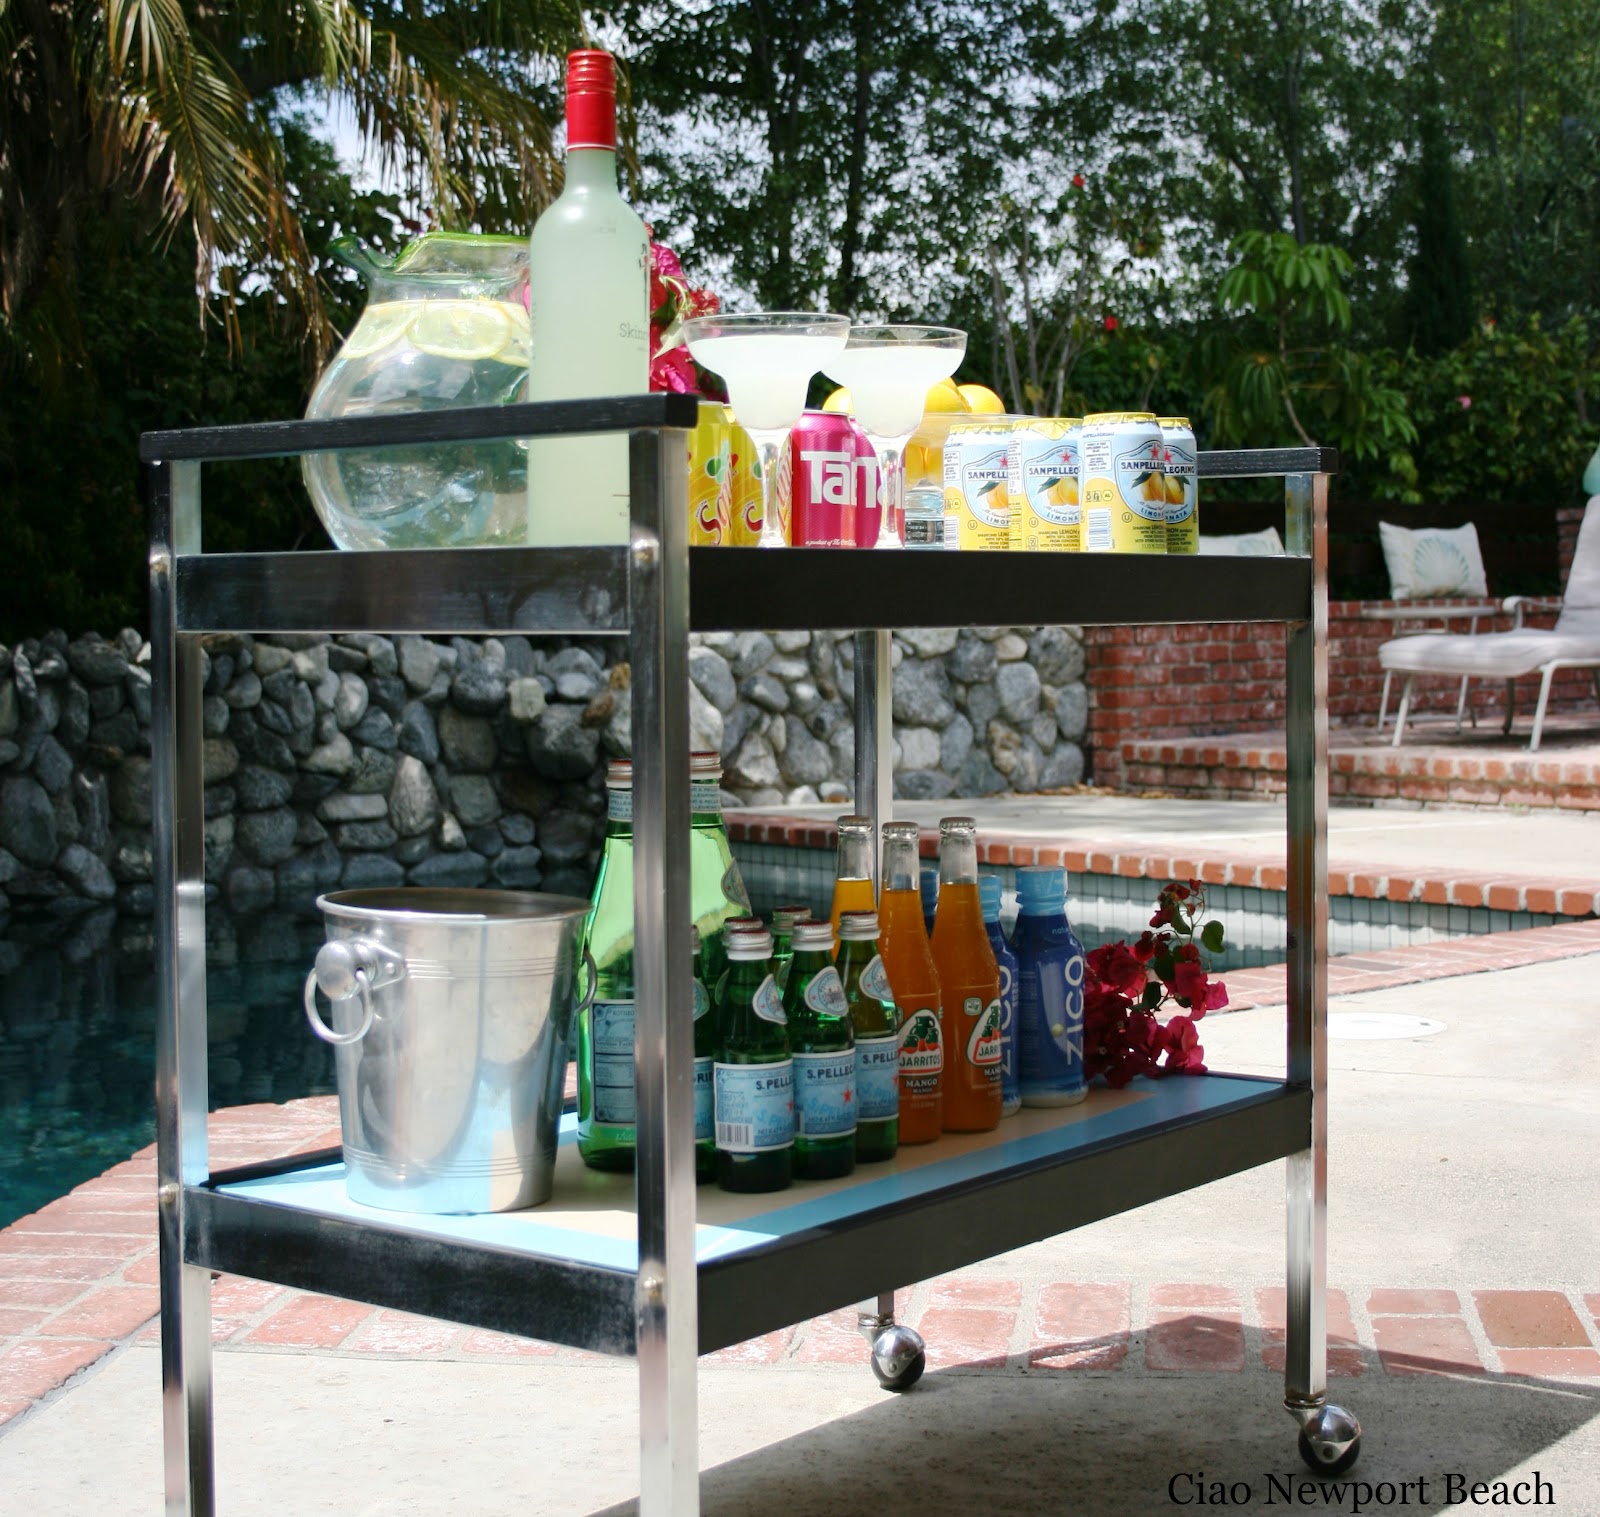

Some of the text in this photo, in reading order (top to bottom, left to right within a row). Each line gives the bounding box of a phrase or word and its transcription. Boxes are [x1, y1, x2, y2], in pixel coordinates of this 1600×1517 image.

[1065, 954, 1084, 1066] ZICO
[899, 1054, 941, 1067] JARRITOS
[906, 1079, 938, 1088] MANGO
